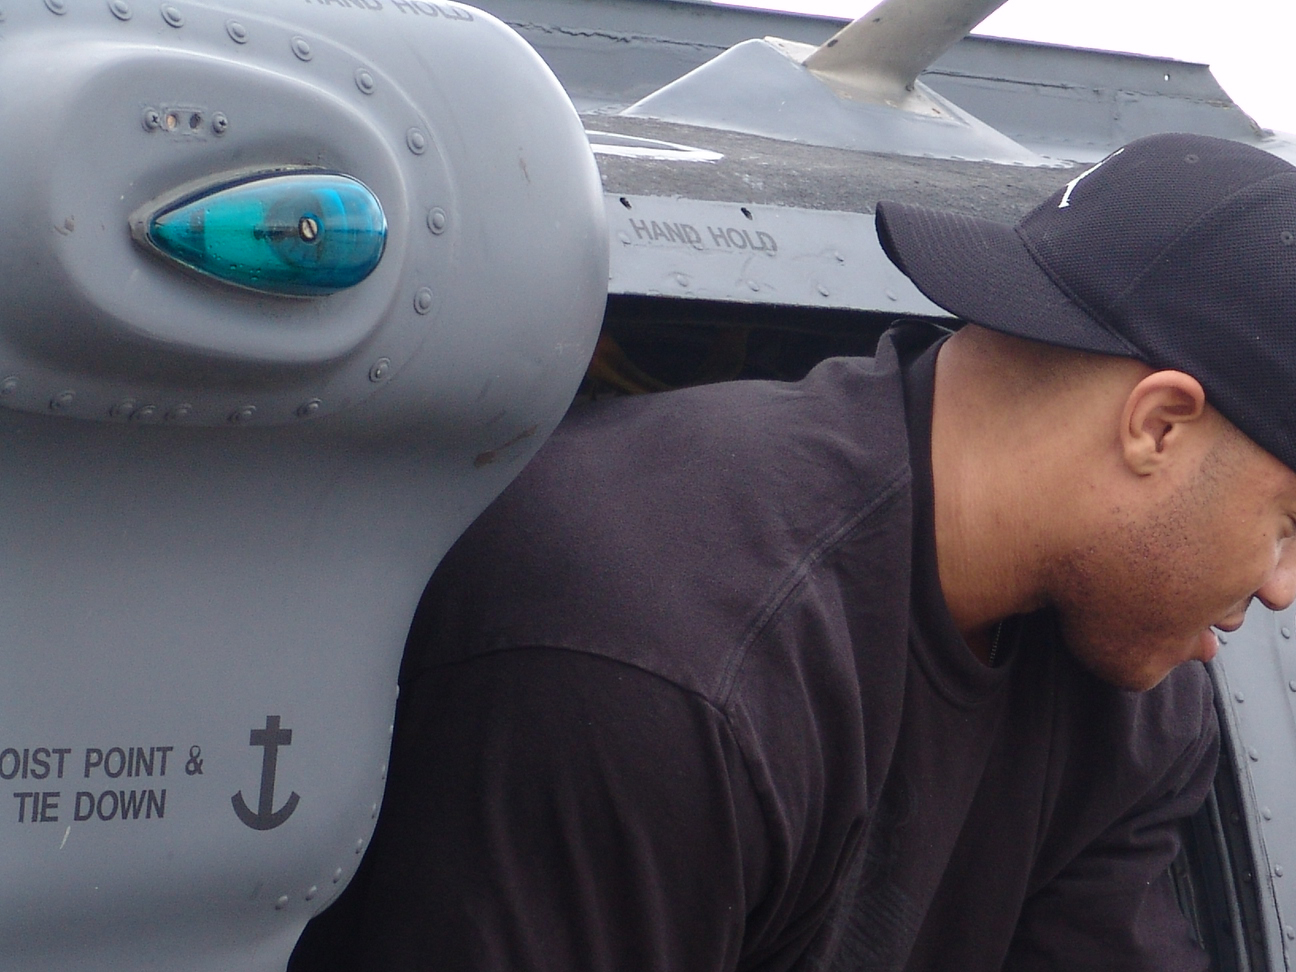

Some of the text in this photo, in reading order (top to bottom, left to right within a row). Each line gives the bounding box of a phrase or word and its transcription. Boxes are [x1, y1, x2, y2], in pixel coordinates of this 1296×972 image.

[303, 0, 474, 22] ND HOLD
[629, 218, 778, 252] HAND HOLD
[84, 746, 173, 778] POINT
[185, 745, 204, 775] &
[13, 789, 167, 823] TIE DOWN
